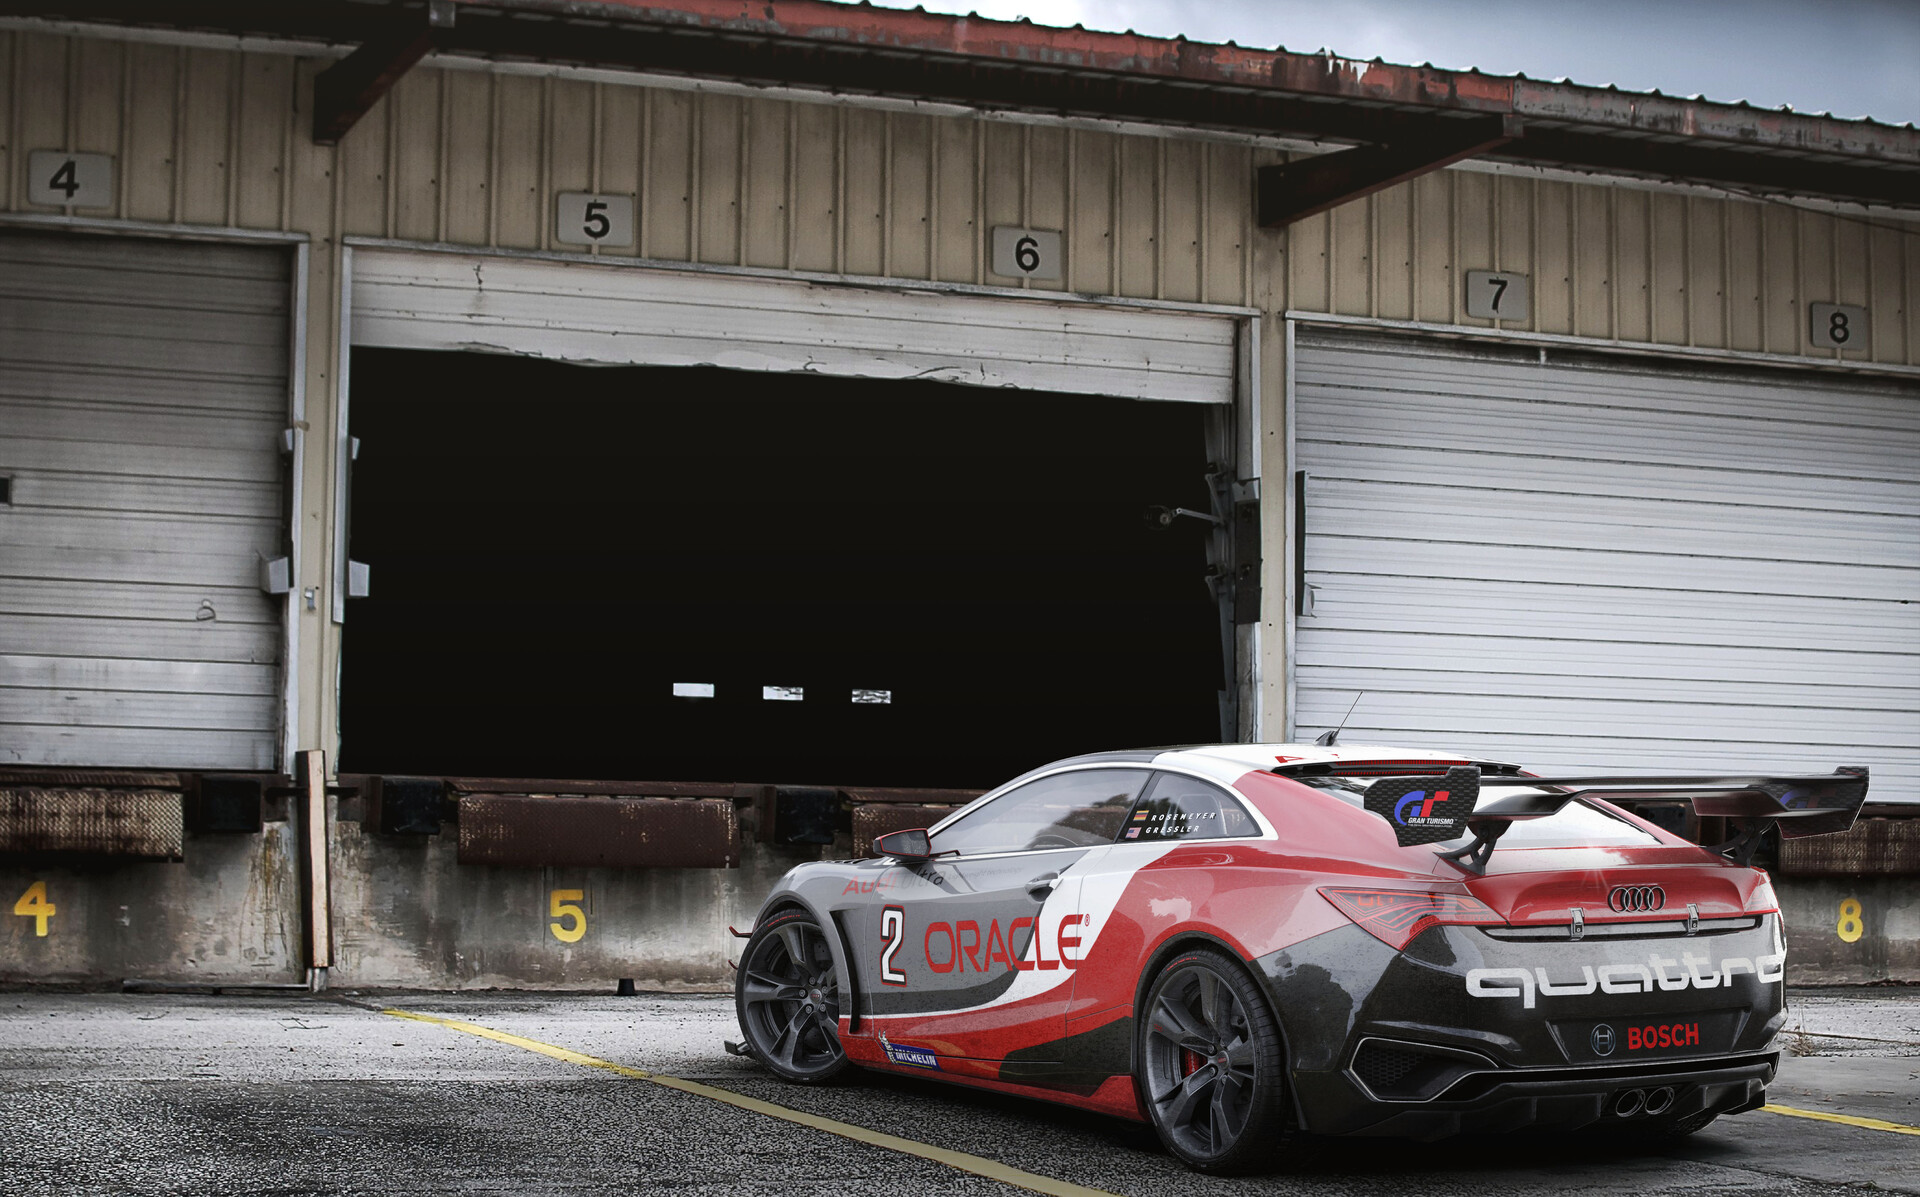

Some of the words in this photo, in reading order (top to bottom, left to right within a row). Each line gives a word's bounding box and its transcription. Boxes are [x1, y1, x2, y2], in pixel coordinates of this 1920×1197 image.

[49, 159, 80, 199] 4
[582, 200, 611, 240] 5
[1014, 236, 1041, 273] 6
[1488, 278, 1509, 312] 7
[1828, 311, 1850, 344] 8
[1145, 825, 1200, 834] GRESSLER
[1150, 812, 1217, 822] ROSEMEYER
[1426, 817, 1454, 825] TURISMO
[14, 881, 56, 937] 4
[549, 889, 588, 943] 5
[1837, 899, 1864, 943] 8
[880, 904, 908, 988] 2
[1627, 1022, 1699, 1050] BOSCH
